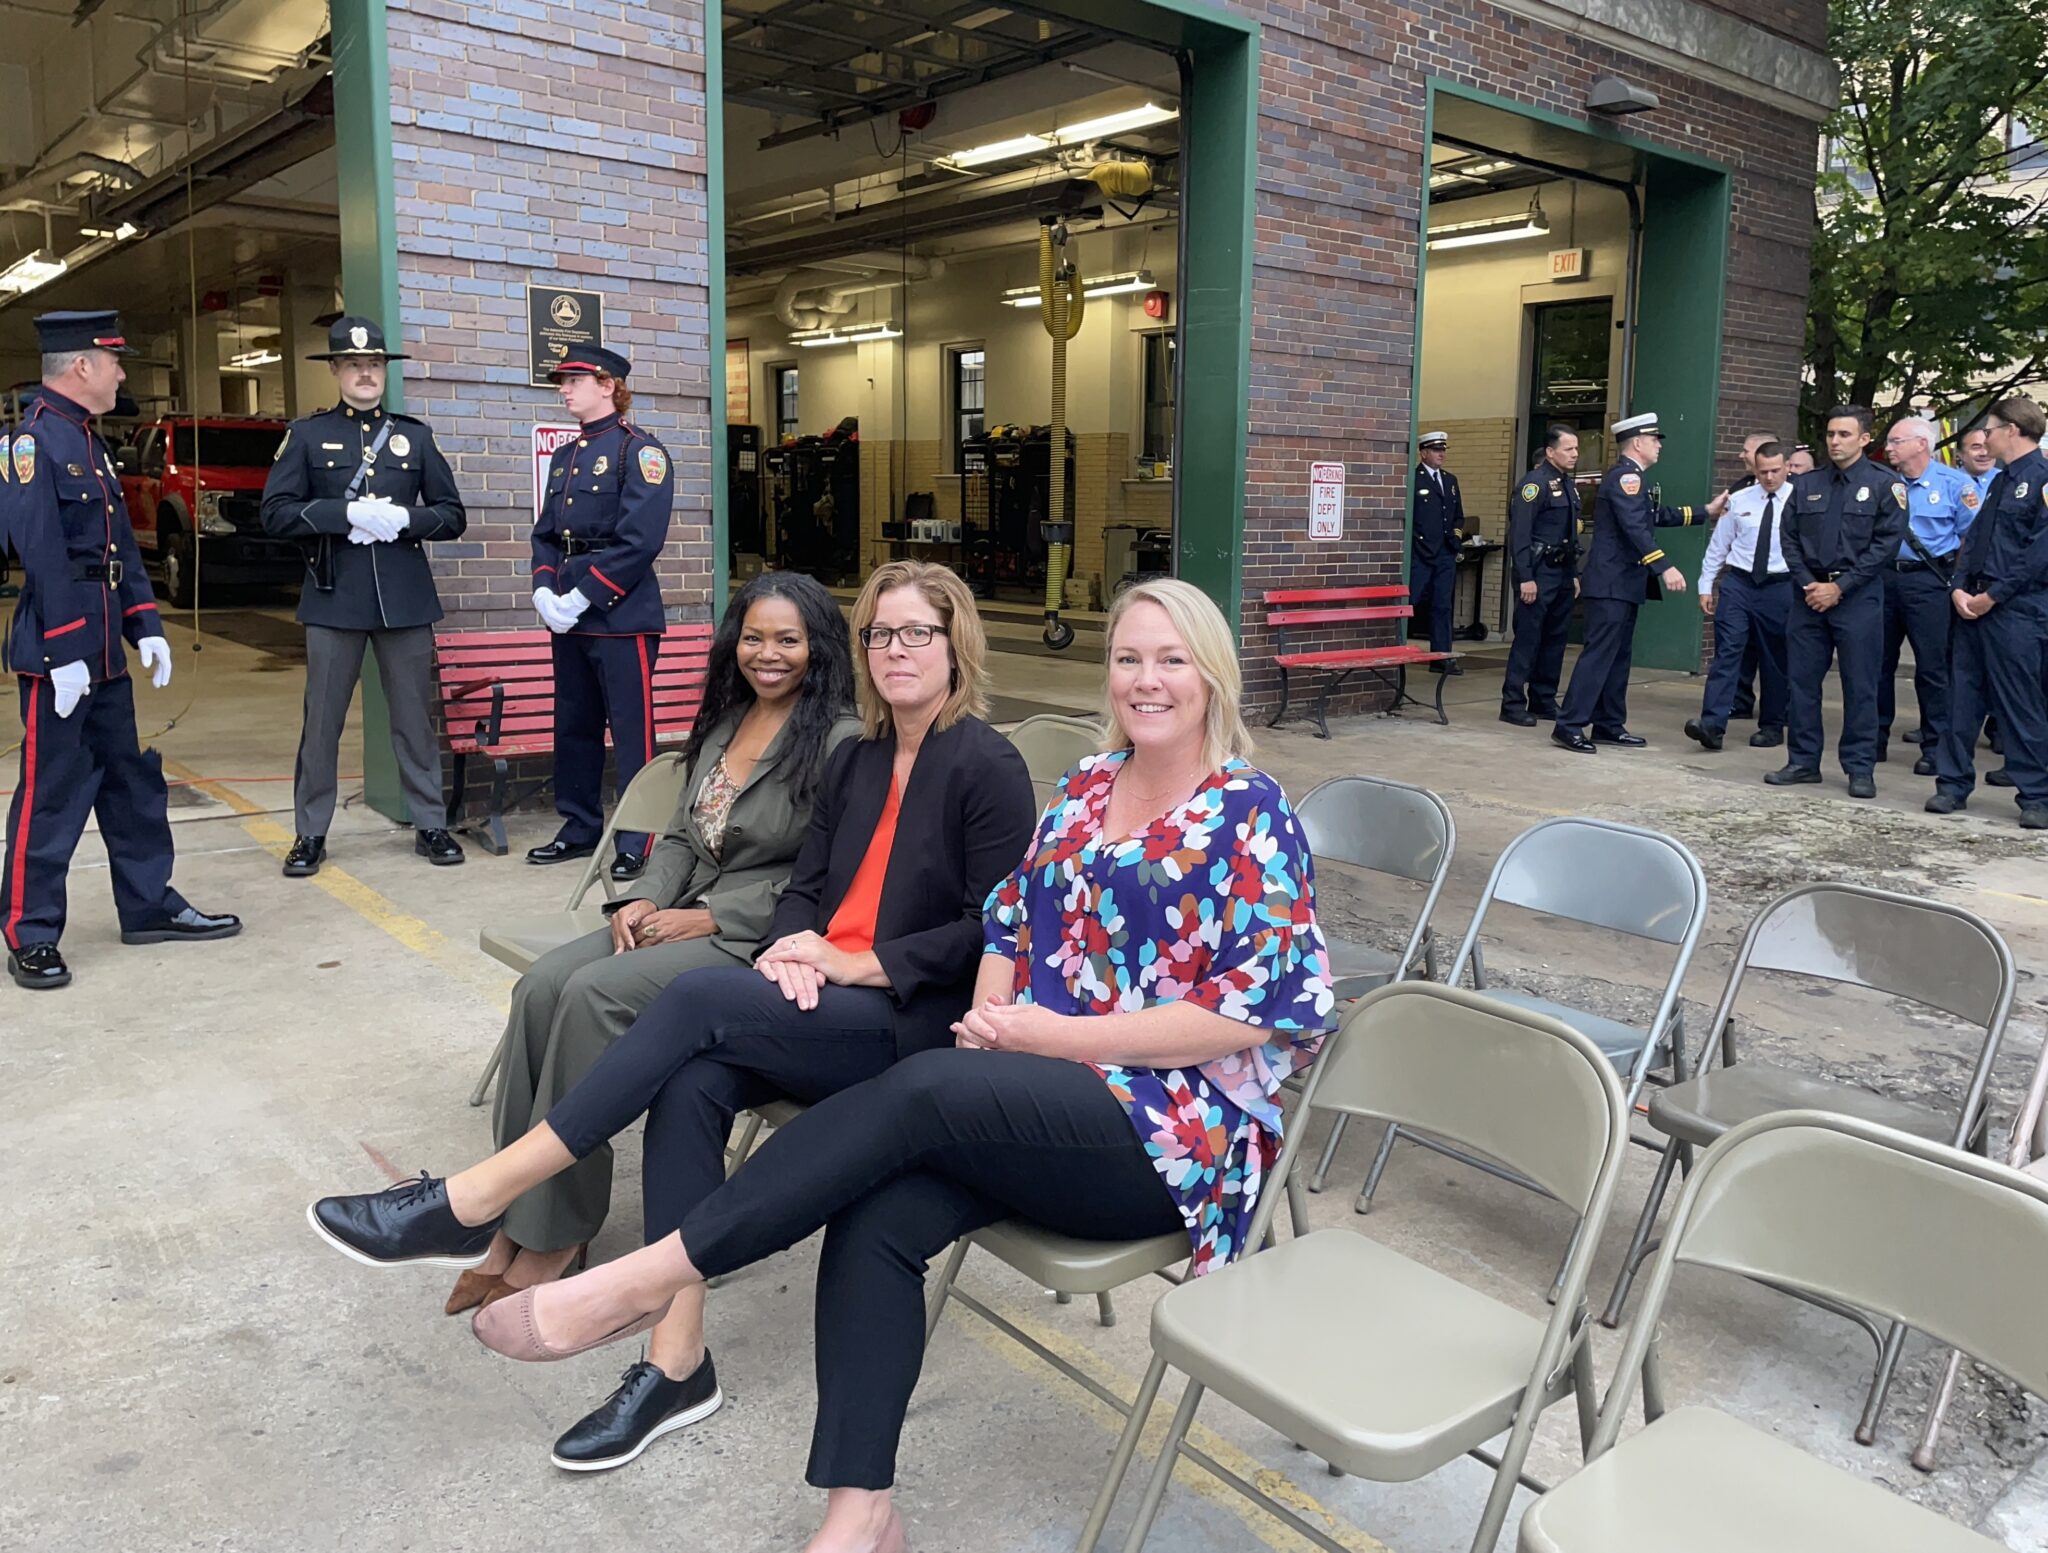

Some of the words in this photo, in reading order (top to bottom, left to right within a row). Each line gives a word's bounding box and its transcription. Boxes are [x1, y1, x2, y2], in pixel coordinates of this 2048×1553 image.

[1554, 253, 1577, 273] EXIT
[537, 431, 557, 453] NO
[1313, 467, 1323, 481] NO
[1323, 468, 1342, 481] PARKING
[1319, 487, 1336, 498] FIRE
[1317, 503, 1336, 515] DEPT
[1316, 521, 1335, 533] ONLY
